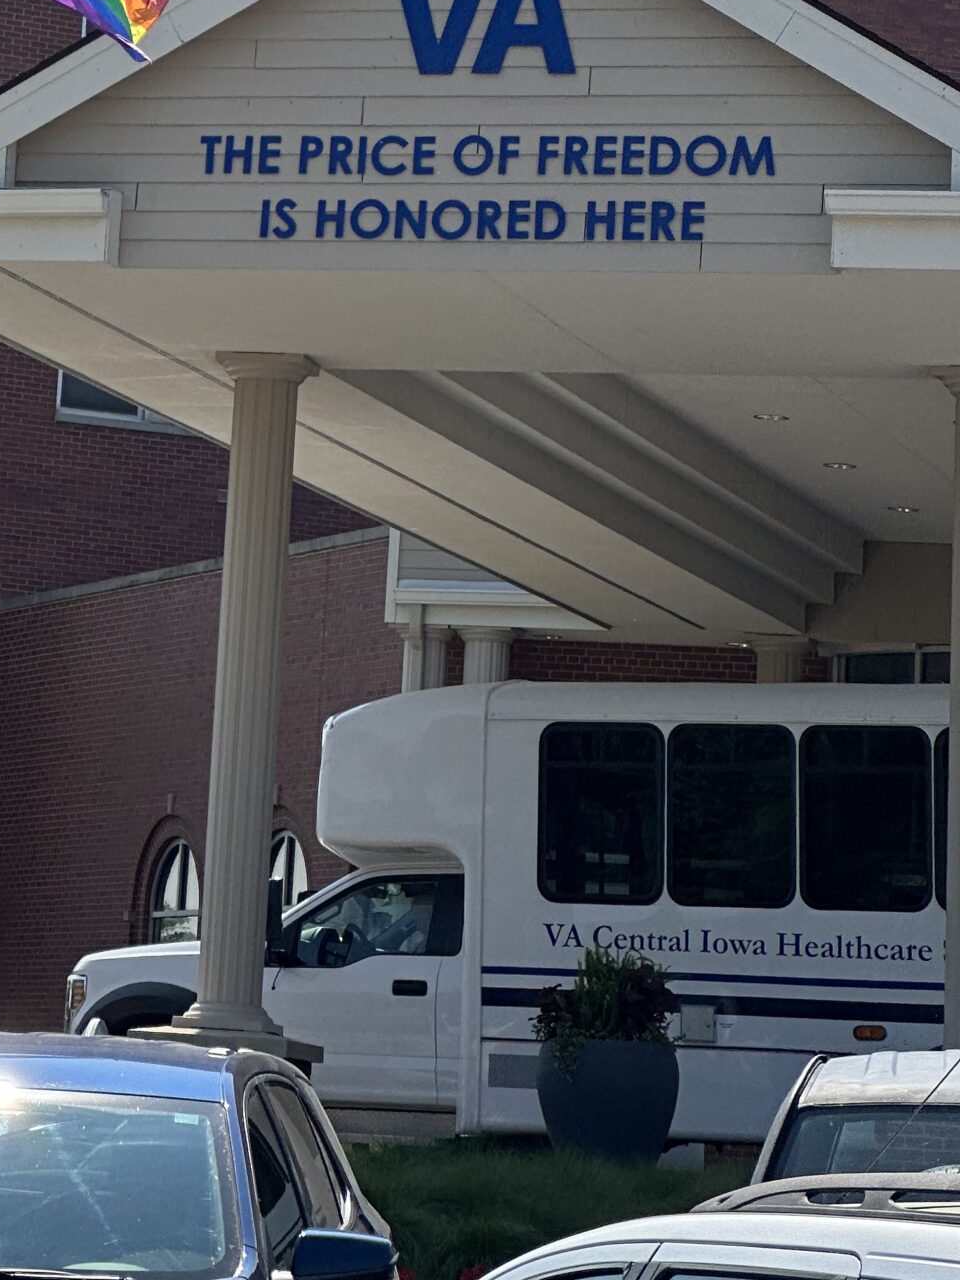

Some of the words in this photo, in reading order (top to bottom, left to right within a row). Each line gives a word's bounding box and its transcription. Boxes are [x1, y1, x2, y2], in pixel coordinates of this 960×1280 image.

[200, 135, 281, 175] THE
[298, 136, 436, 175] PRICE
[453, 135, 520, 176] OF
[537, 135, 776, 176] FREEDOM
[258, 198, 297, 239] IS
[315, 199, 566, 240] HONORED
[585, 200, 705, 242] HERE
[543, 923, 585, 948] VA
[592, 925, 691, 952] Central
[700, 929, 767, 956] Iowa
[776, 932, 933, 962] Healthcare
